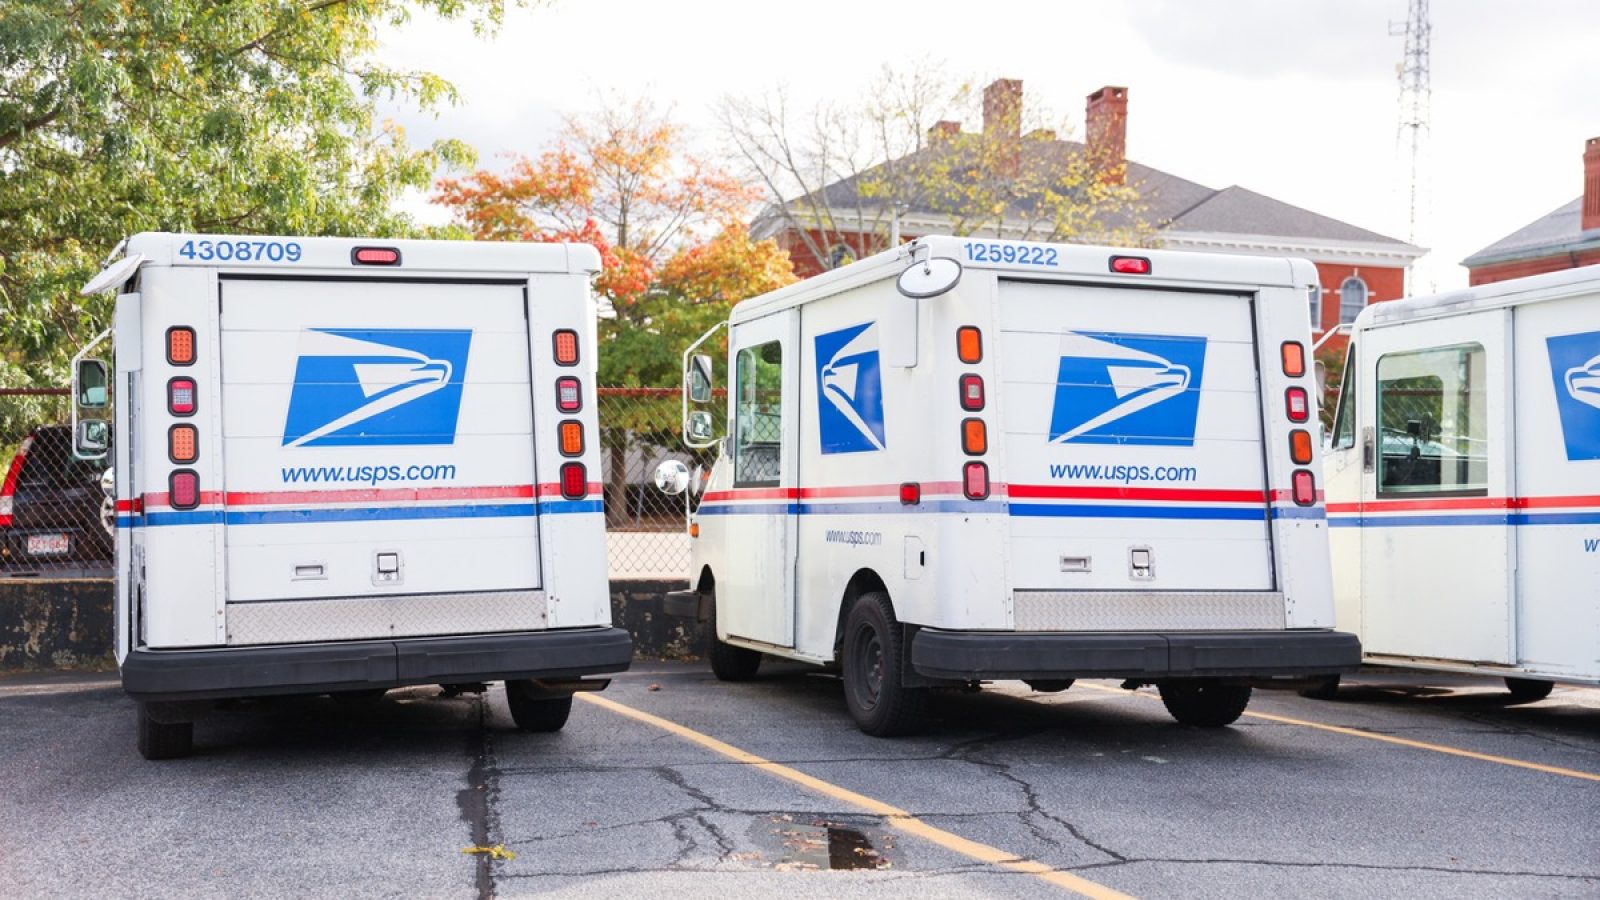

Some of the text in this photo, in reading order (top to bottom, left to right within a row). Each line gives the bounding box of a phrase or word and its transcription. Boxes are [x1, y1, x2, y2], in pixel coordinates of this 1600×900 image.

[179, 240, 302, 262] 4308709
[963, 243, 1058, 266] 1259222
[281, 464, 456, 486] www.usps.com
[1050, 464, 1197, 484] www.usps.com
